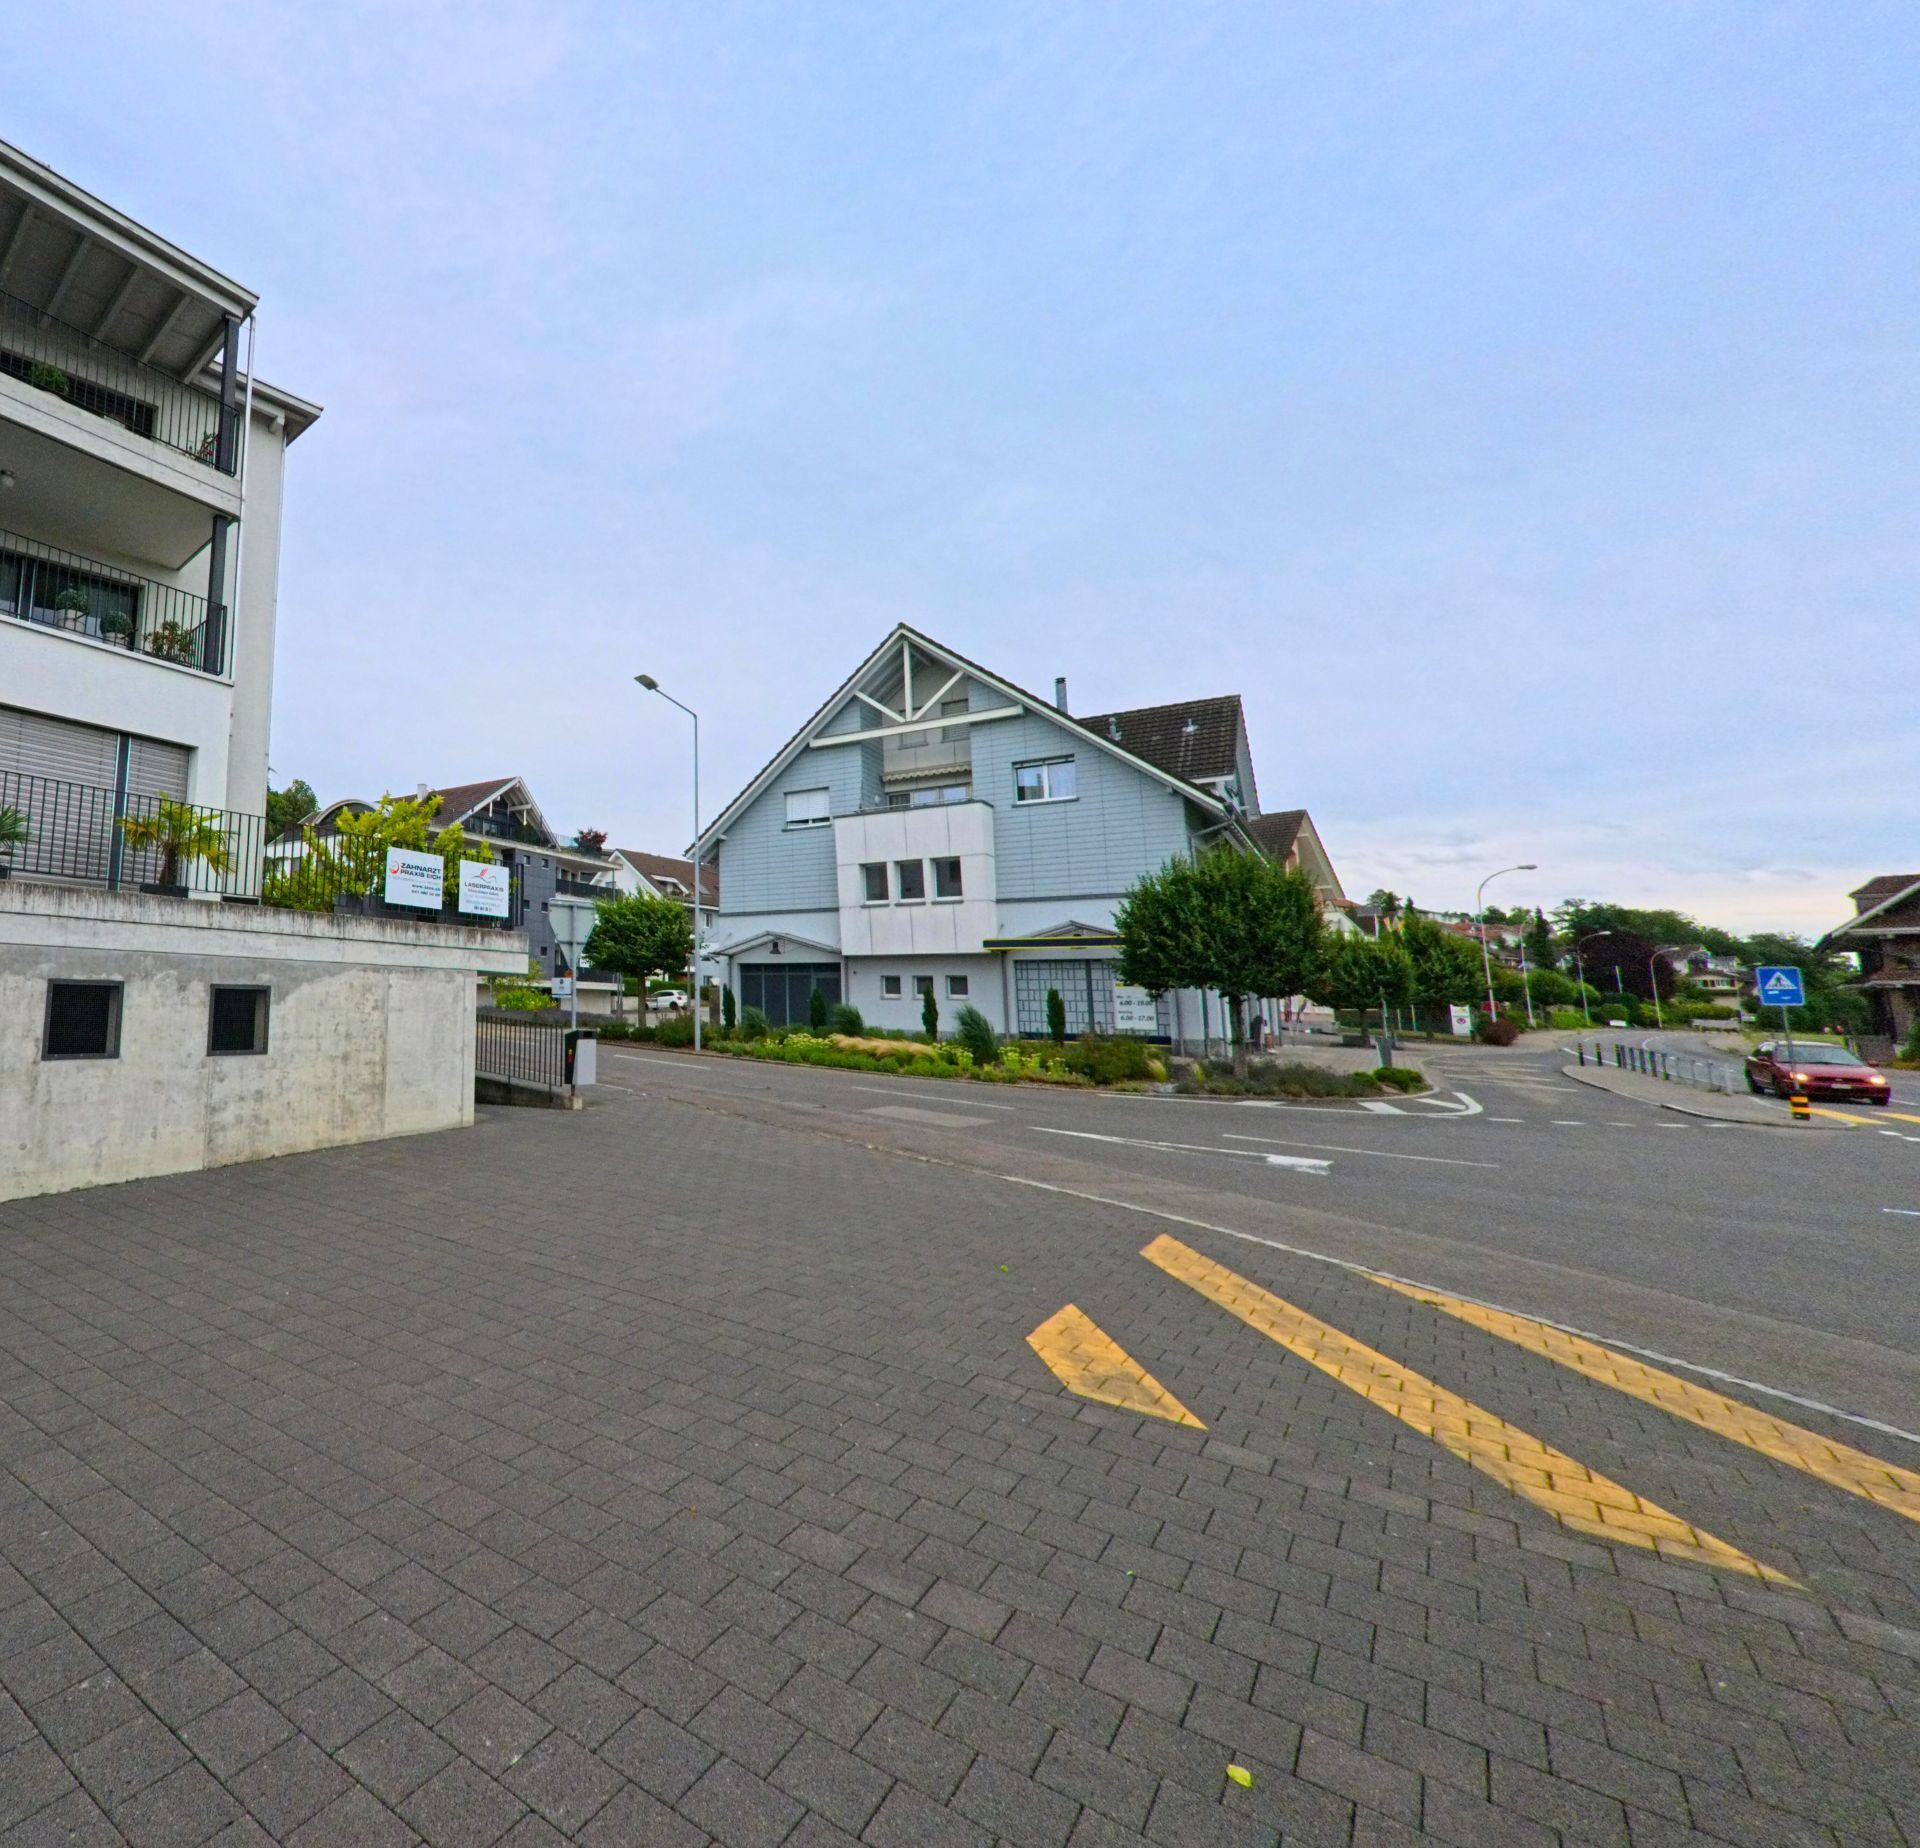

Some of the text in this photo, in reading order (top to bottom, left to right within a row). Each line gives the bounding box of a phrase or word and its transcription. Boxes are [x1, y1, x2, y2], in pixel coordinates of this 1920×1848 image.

[400, 862, 441, 874] ZAHNARZT
[400, 869, 425, 878] PRAXIS
[426, 873, 441, 881] EICH
[464, 881, 504, 893] LASERPRAXIS
